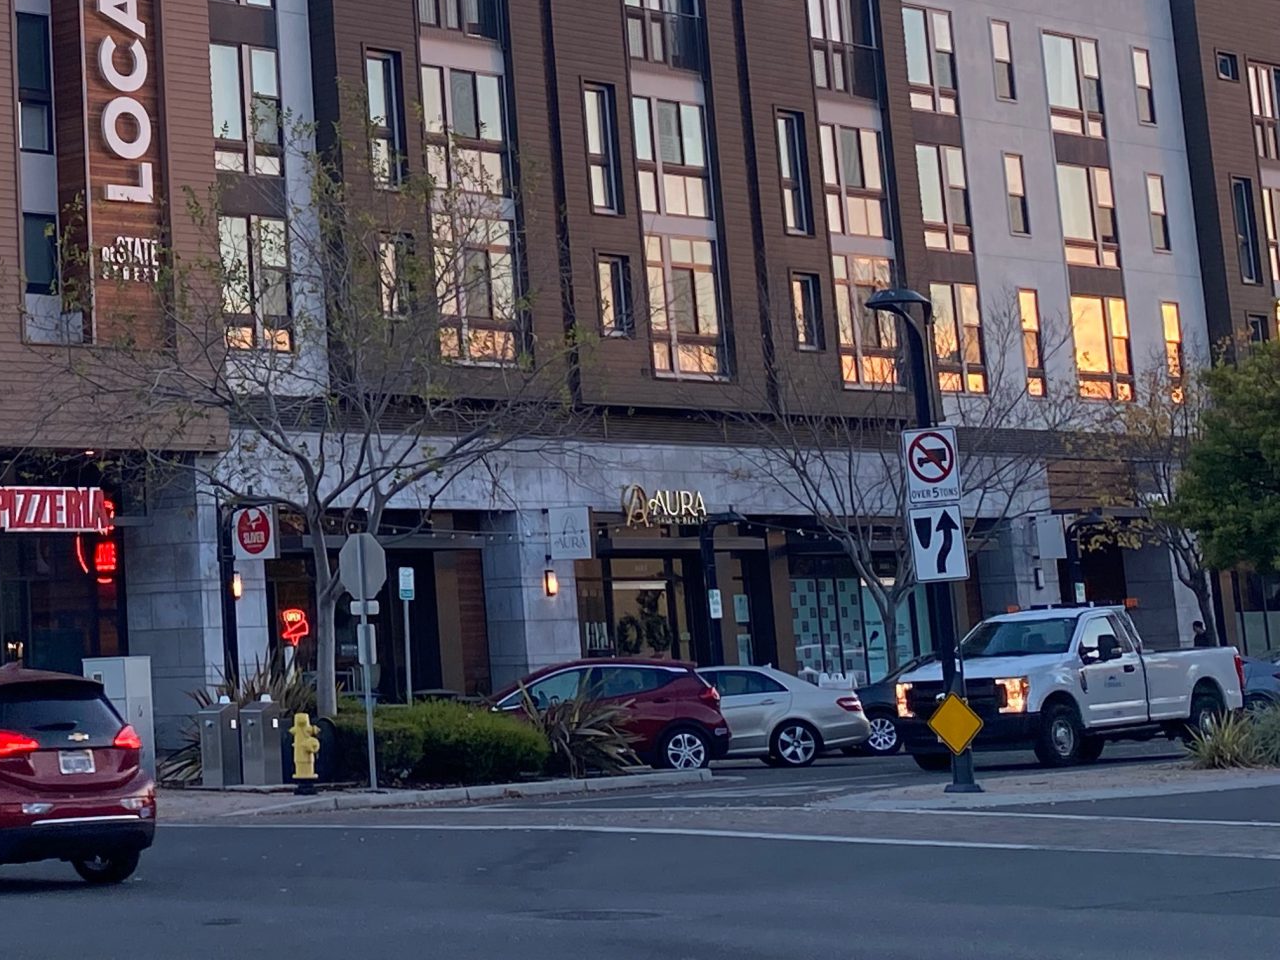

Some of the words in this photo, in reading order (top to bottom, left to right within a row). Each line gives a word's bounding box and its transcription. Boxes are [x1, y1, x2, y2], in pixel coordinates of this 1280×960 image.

[116, 235, 160, 266] STATE
[911, 489, 931, 499] OVER
[932, 486, 940, 499] 5
[940, 487, 959, 497] TONS
[648, 490, 707, 516] AURA
[286, 613, 301, 622] OPEN
